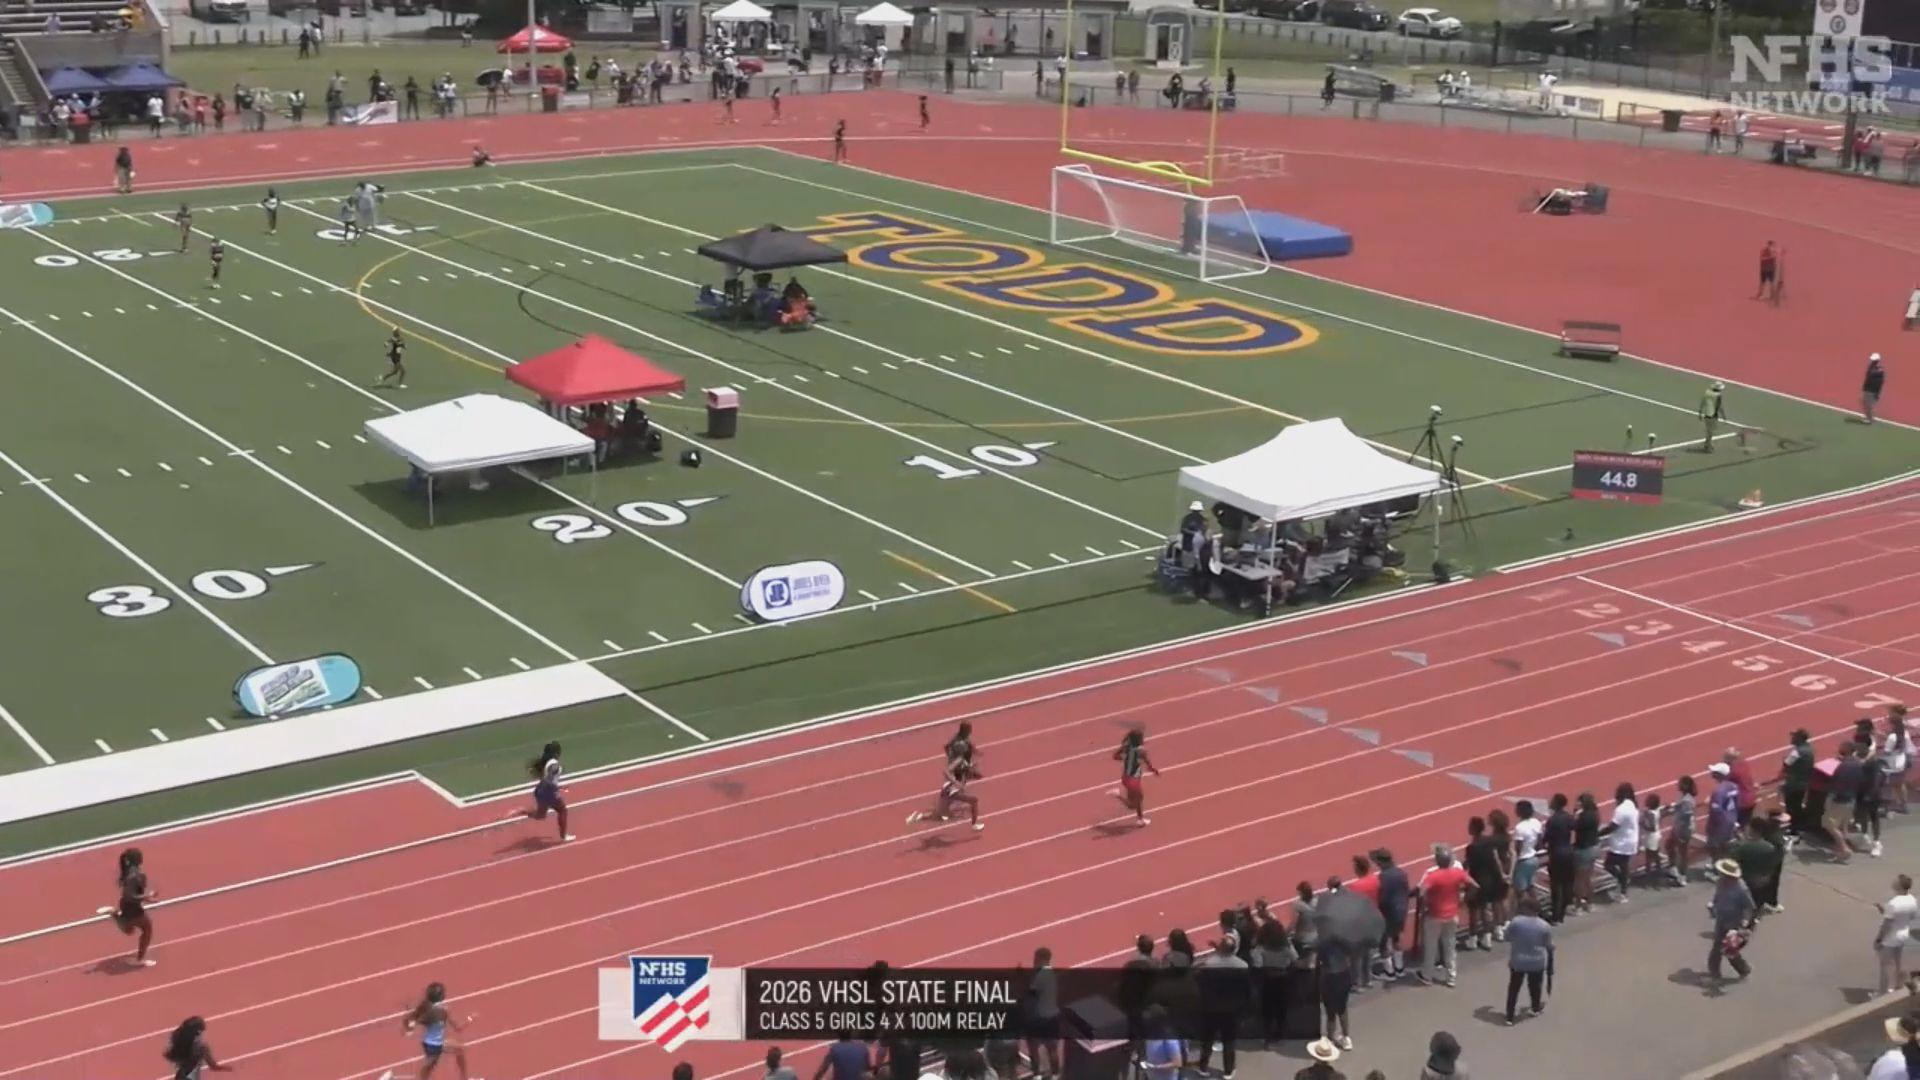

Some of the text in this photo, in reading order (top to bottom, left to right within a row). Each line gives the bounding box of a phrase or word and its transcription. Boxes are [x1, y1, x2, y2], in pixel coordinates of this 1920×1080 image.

[790, 210, 1321, 356] TODD
[903, 443, 1042, 480] 10
[1600, 471, 1638, 488] 44.8
[531, 499, 690, 544] 20
[86, 569, 270, 618] 30
[1572, 602, 1622, 619] 2
[1624, 619, 1675, 636] 3
[1680, 638, 1728, 654] 4
[1731, 654, 1784, 673] 5
[1789, 673, 1838, 691] 6
